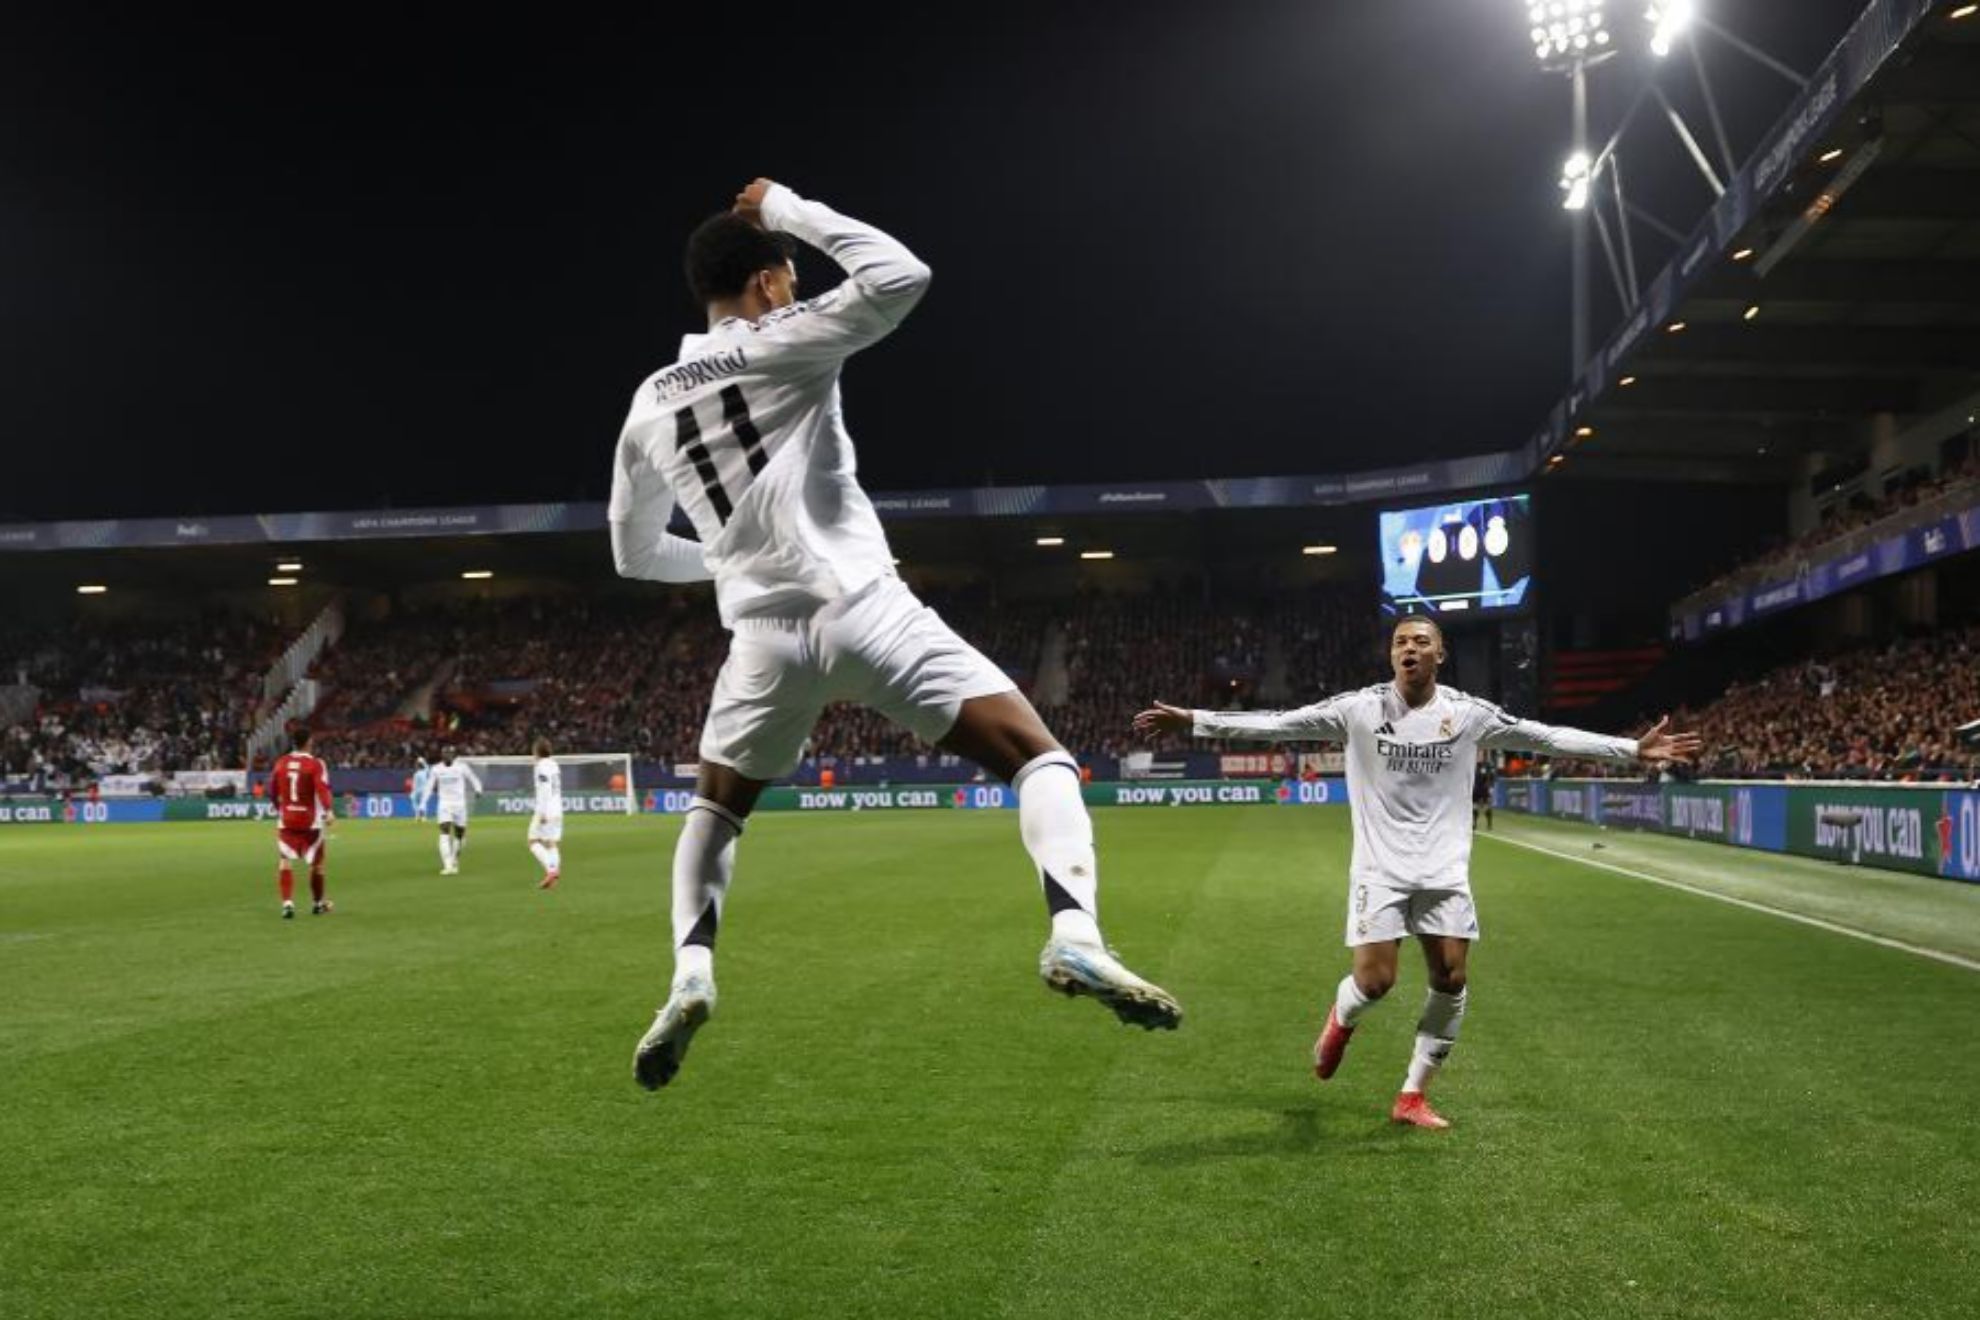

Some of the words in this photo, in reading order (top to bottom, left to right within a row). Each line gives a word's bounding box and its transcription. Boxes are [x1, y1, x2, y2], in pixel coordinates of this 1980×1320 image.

[674, 383, 770, 528] 11
[1377, 739, 1453, 759] Emirates
[590, 797, 628, 811] can
[800, 791, 847, 808] now
[852, 791, 892, 811] you
[897, 790, 938, 807] can
[1116, 787, 1165, 803] now
[1169, 787, 1213, 807] you
[1217, 785, 1260, 801] can
[15, 806, 52, 821] can
[207, 802, 249, 818] now
[1888, 807, 1923, 859] can
